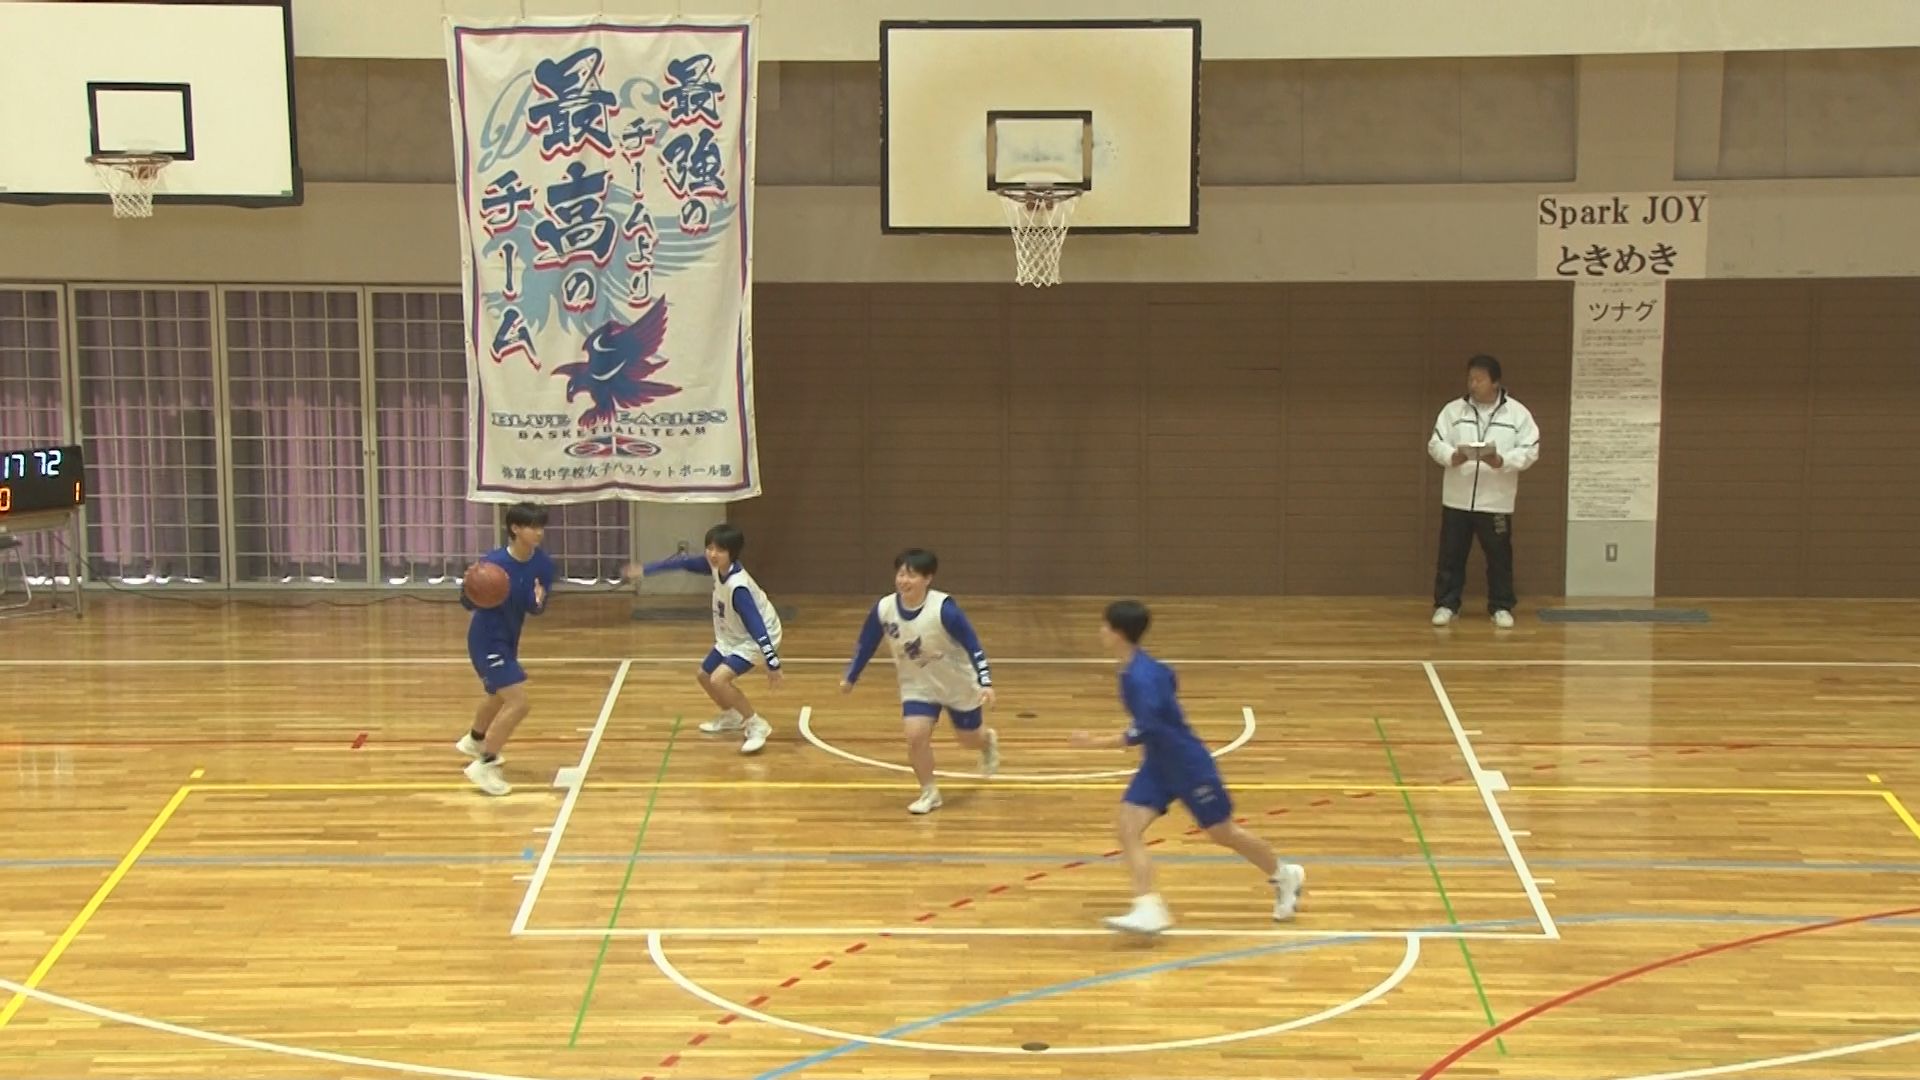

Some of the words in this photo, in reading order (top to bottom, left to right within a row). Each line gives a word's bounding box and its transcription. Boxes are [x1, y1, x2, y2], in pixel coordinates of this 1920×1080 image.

[658, 53, 728, 235] 最強の
[526, 47, 620, 313] 最高の
[621, 116, 659, 308] チームより
[1539, 196, 1630, 229] Spark
[1642, 195, 1708, 225] JOY
[480, 169, 541, 372] チーム
[1556, 242, 1678, 276] ときめき
[1588, 299, 1659, 322] ツナグ
[491, 411, 571, 428] BLUE
[615, 409, 729, 427] EAGLES
[501, 461, 733, 481] 弥富北中学校女子バスケットボール部
